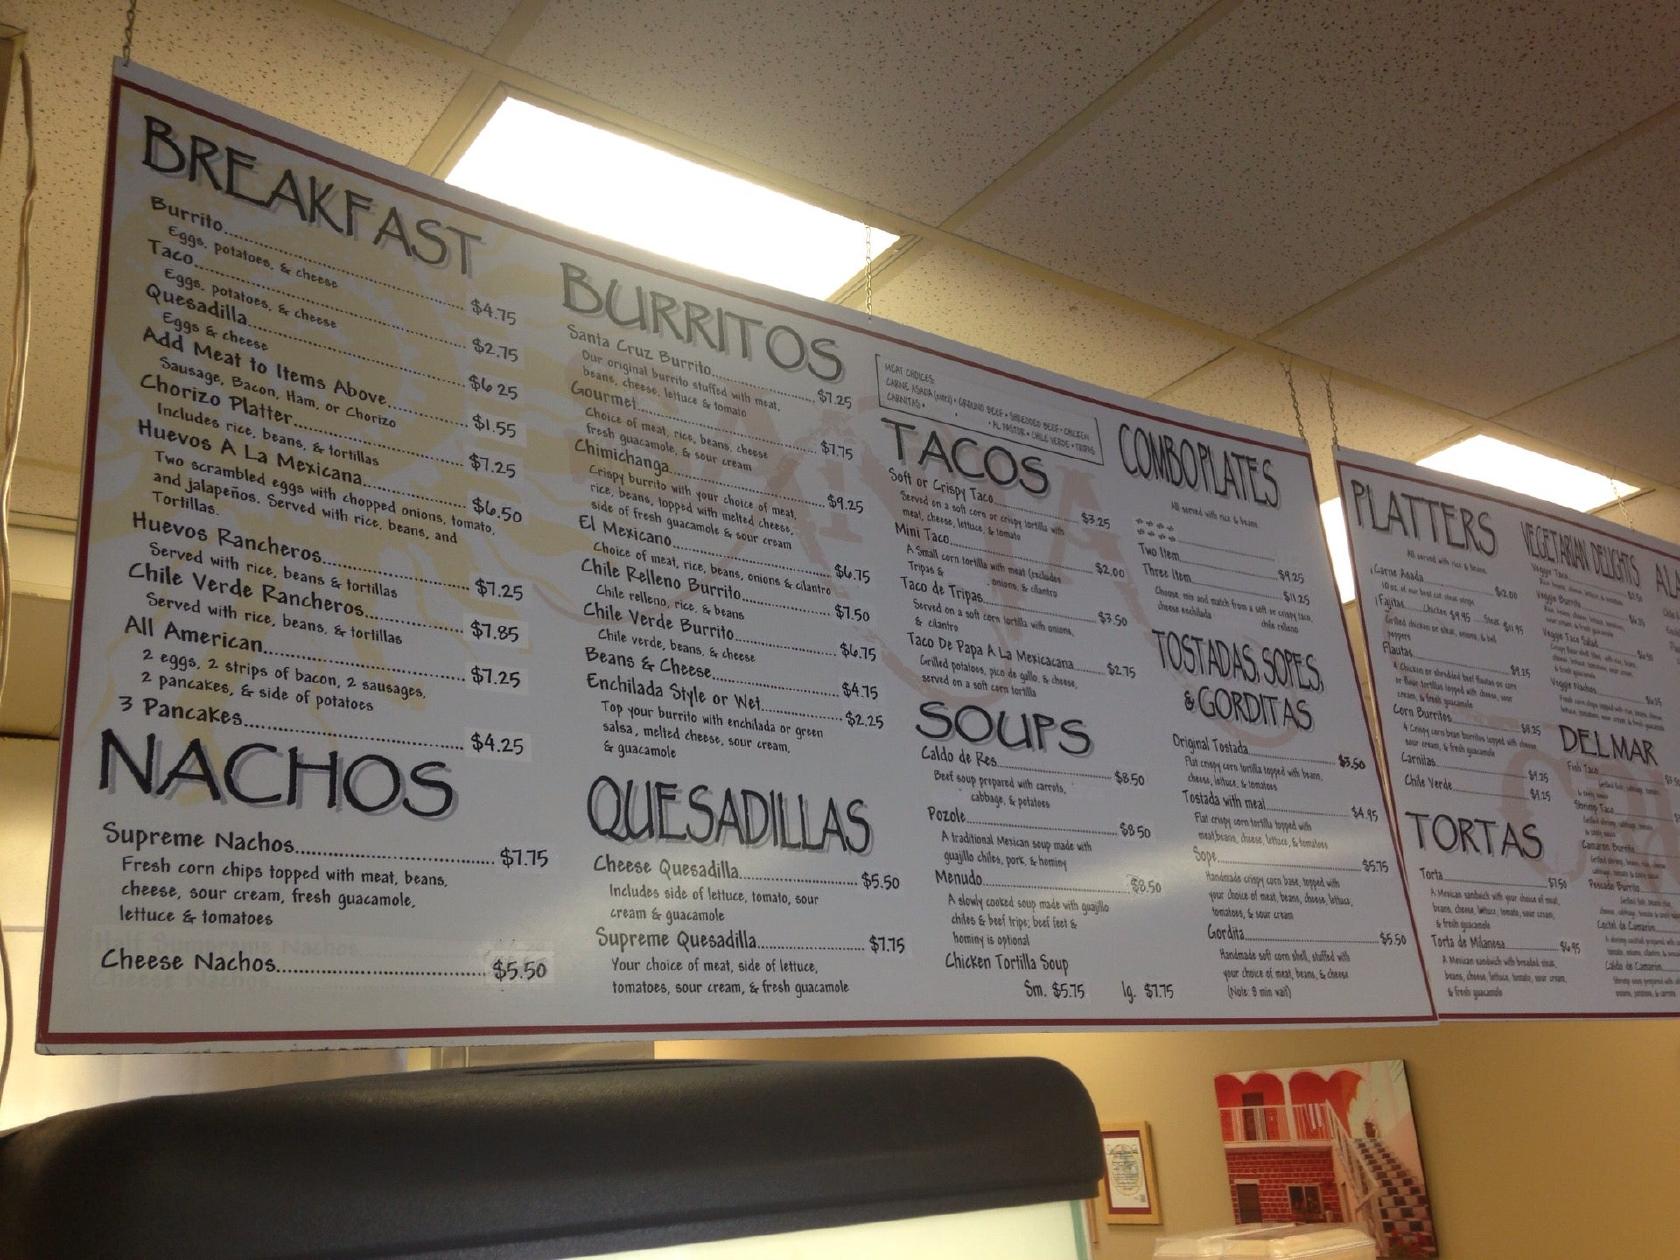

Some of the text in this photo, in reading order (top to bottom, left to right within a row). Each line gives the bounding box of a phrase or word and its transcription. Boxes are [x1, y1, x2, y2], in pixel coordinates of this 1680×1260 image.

[141, 115, 483, 275] BREAKFAST
[150, 196, 517, 326] Burrito $4.75
[146, 284, 247, 326] Quesadilla
[560, 263, 842, 381] BURRITOS
[162, 312, 268, 351] Eggs & cheese
[143, 327, 516, 438] Add Meat to Items Above $1.55
[567, 324, 852, 409] Santa Cruz Burrito $7.25
[140, 373, 293, 426] Chorizo Platter
[159, 356, 224, 387] Sausage,
[326, 402, 339, 414] or
[345, 403, 396, 428] Chorizo
[571, 381, 853, 460] Gourmet $7.75
[137, 418, 522, 524] Huevos A La Mexicana $6.50
[574, 439, 864, 514] Chimichanga $9.25
[881, 418, 1049, 494] TACOS
[888, 468, 994, 503] Soft or Crispy Taco
[1351, 480, 1496, 556] PLATTERS
[579, 515, 870, 583] El Mexicano $6.75
[895, 523, 1125, 578] Mini Taco $2.00
[1138, 543, 1157, 557] Two
[1143, 563, 1168, 577] Three
[1521, 521, 1640, 587] VEGETARIAN DELIGHTS
[128, 563, 519, 643] Chile Verde Rancheros $7.85
[580, 559, 870, 622] Chile Relleno Burrito $7.50
[901, 577, 983, 602] Taco de Tripas
[124, 615, 263, 654] All American
[907, 632, 934, 648] Taco
[939, 638, 952, 650] De
[957, 639, 983, 659] Papa
[988, 645, 996, 656] A
[999, 647, 1012, 660] La
[585, 647, 878, 699] Beans & Cheese $4.75
[587, 673, 883, 729] Enchilada Style or Wet $2.25
[1184, 686, 1312, 730] & GORDITAS
[1393, 703, 1414, 717] Corn
[119, 696, 523, 756] 3 Pancakes $4.25
[916, 701, 1091, 754] SOUPS
[1173, 734, 1249, 755] Original Tostada
[99, 728, 454, 817] NACHOS
[921, 746, 1144, 786] Caldo de Res $8.50
[1405, 773, 1425, 787] Chile
[587, 775, 871, 853] QUESADILLAS
[928, 806, 966, 822] Pozole
[1182, 790, 1219, 805] Tostada
[1223, 795, 1241, 808] with
[103, 822, 549, 869] Supreme Nachos $7.75
[1405, 811, 1543, 858] TORTAS
[122, 856, 448, 887] Fresh corn chips topped with meat, beans,
[594, 855, 900, 890] Cheese Quesadilla $5.50
[609, 884, 819, 905] Includes side of lettuce, tomato, sour
[935, 870, 1161, 893] Menudo $8.50
[1419, 867, 1443, 880] Torta
[1208, 924, 1244, 940] Gordita
[1431, 934, 1454, 948] Torta
[1458, 937, 1467, 948] de
[946, 952, 1068, 976] Chicken Tortilla Soup
[1024, 980, 1047, 998] Sm.
[1052, 982, 1084, 999] $5.75
[1144, 982, 1173, 999] $7.75
